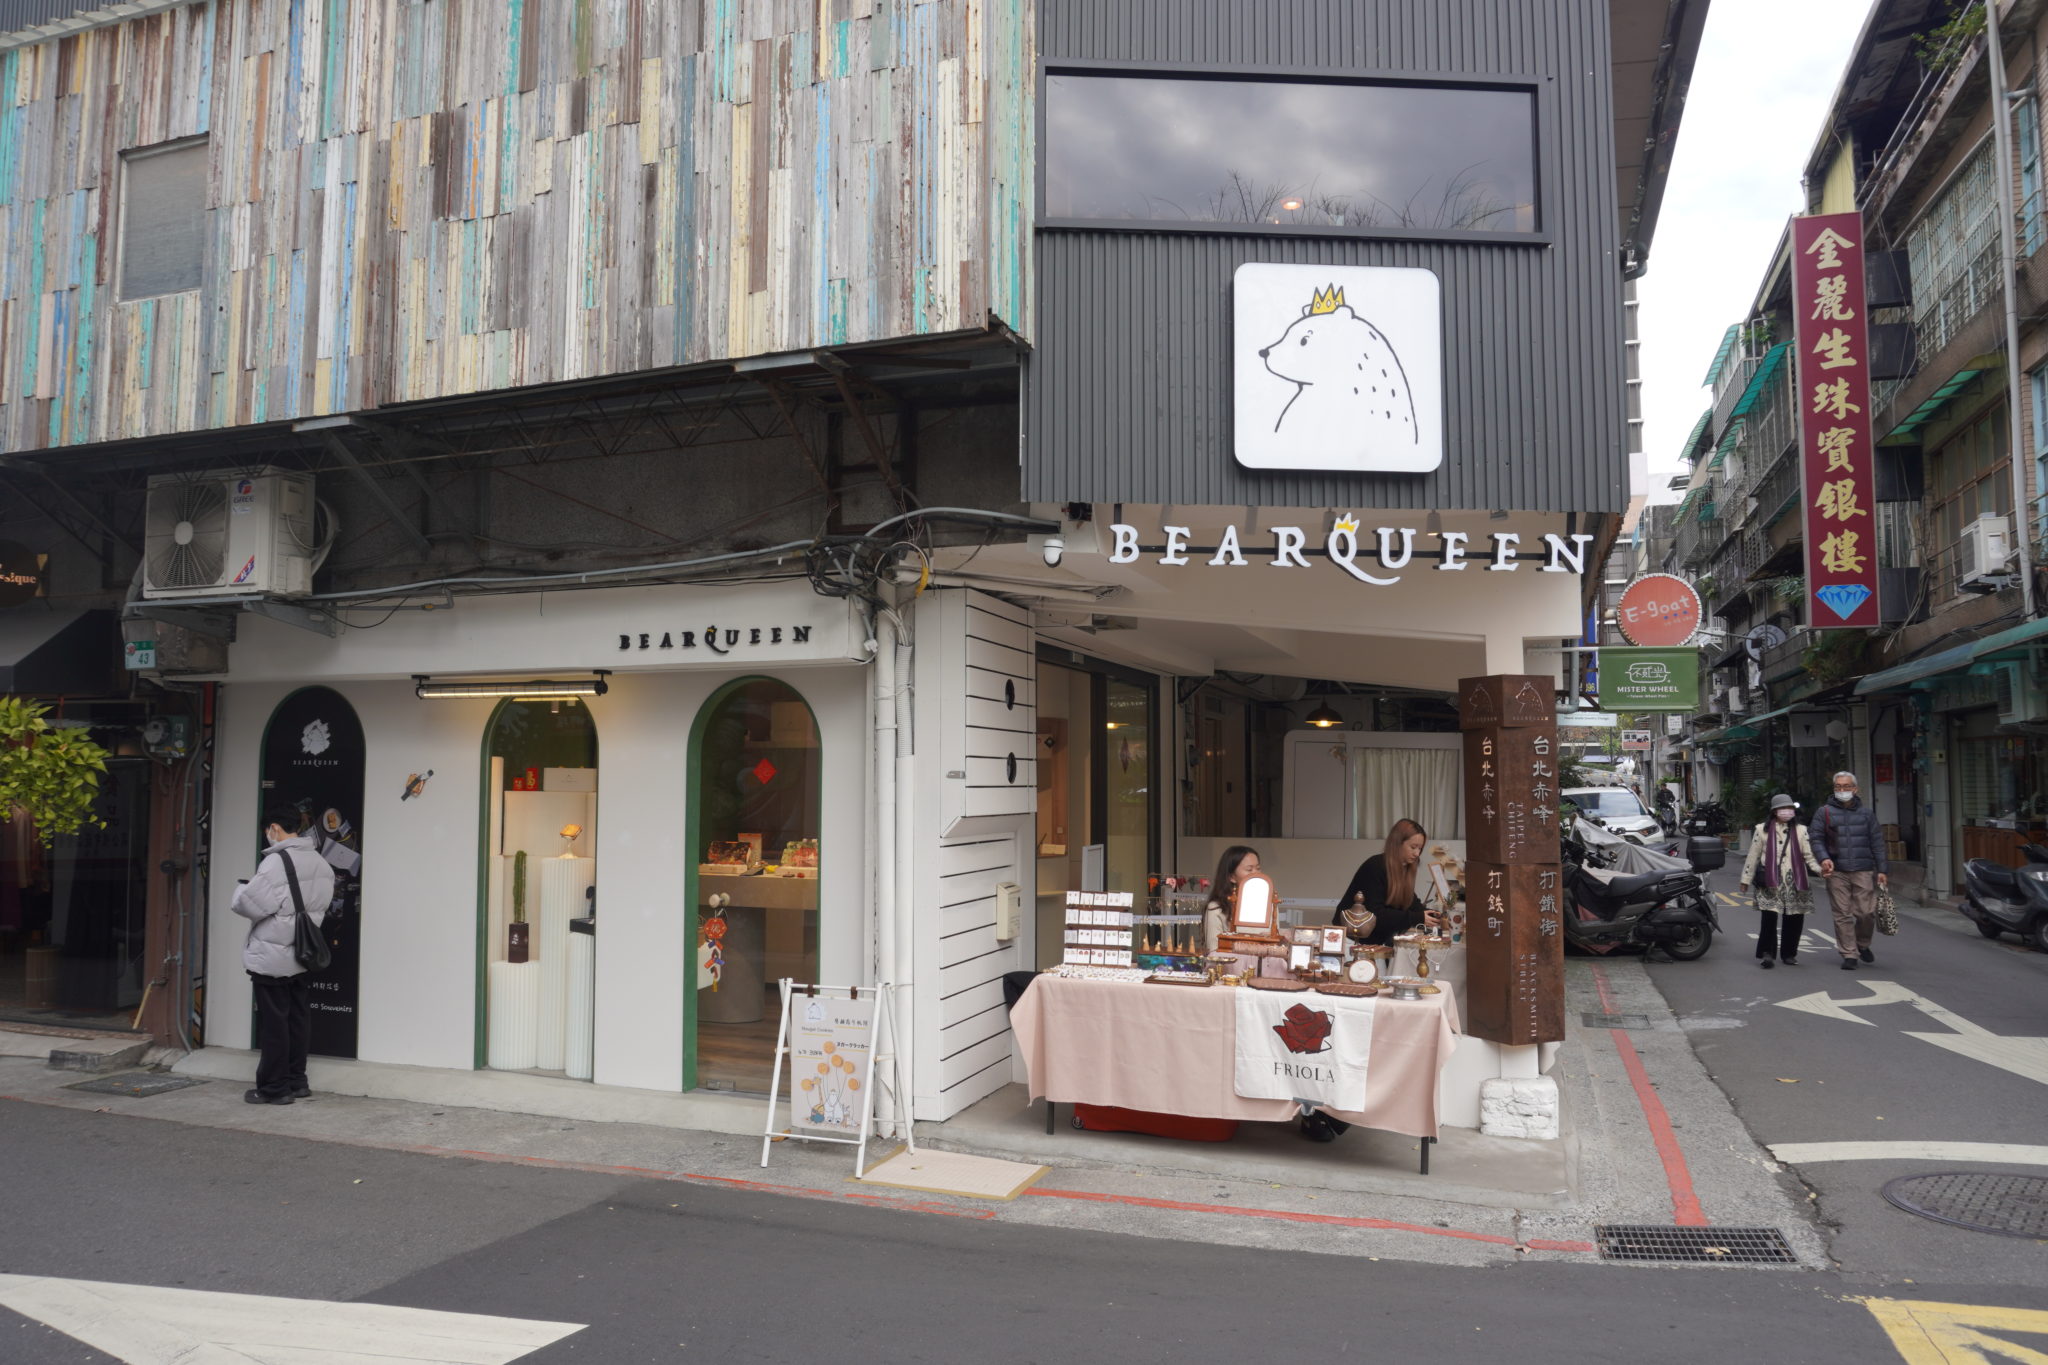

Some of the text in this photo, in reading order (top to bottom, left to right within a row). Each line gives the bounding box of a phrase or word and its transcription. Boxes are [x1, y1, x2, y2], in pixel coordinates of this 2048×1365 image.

[1805, 227, 1867, 574] 金麗生珠寶銀樓
[1109, 523, 1594, 585] BEARQUEEN
[1625, 595, 1690, 622] E-goat
[138, 652, 149, 664] 43
[619, 626, 812, 653] BEARQUEEN
[1481, 736, 1496, 825] 台北赤峰
[1532, 735, 1553, 825] 台北赤峰
[1507, 801, 1517, 859] CHIFENG
[1515, 802, 1525, 844] TAIPEI
[1487, 870, 1504, 937] 打鉄町
[1539, 870, 1558, 937] 打鐵街
[1519, 953, 1527, 1001] STREET
[1529, 953, 1537, 1038] BLACKSMITH
[1273, 1062, 1335, 1083] FRIOLA
